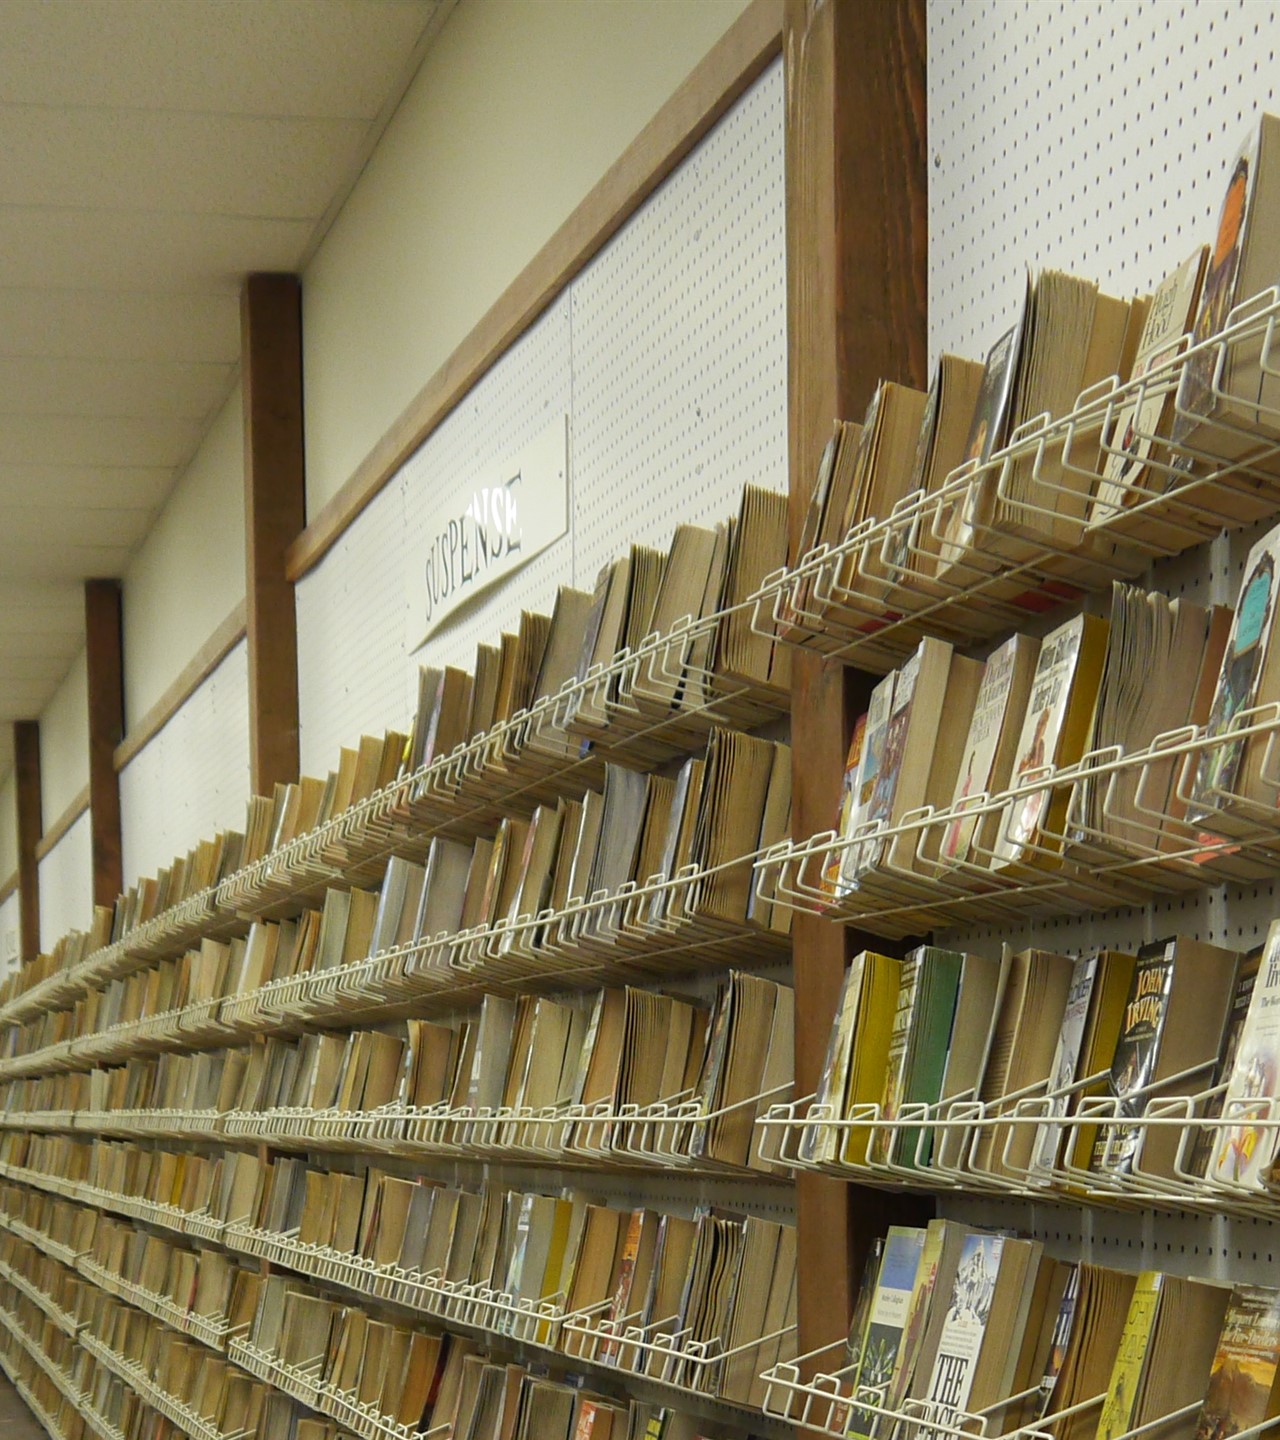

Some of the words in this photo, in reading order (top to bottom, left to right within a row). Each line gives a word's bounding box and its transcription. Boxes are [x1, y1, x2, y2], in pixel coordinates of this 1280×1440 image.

[425, 468, 522, 622] SUSPENSE
[1136, 967, 1166, 1000] JOHN
[1125, 997, 1163, 1034] IRVING
[931, 1353, 970, 1408] THE
